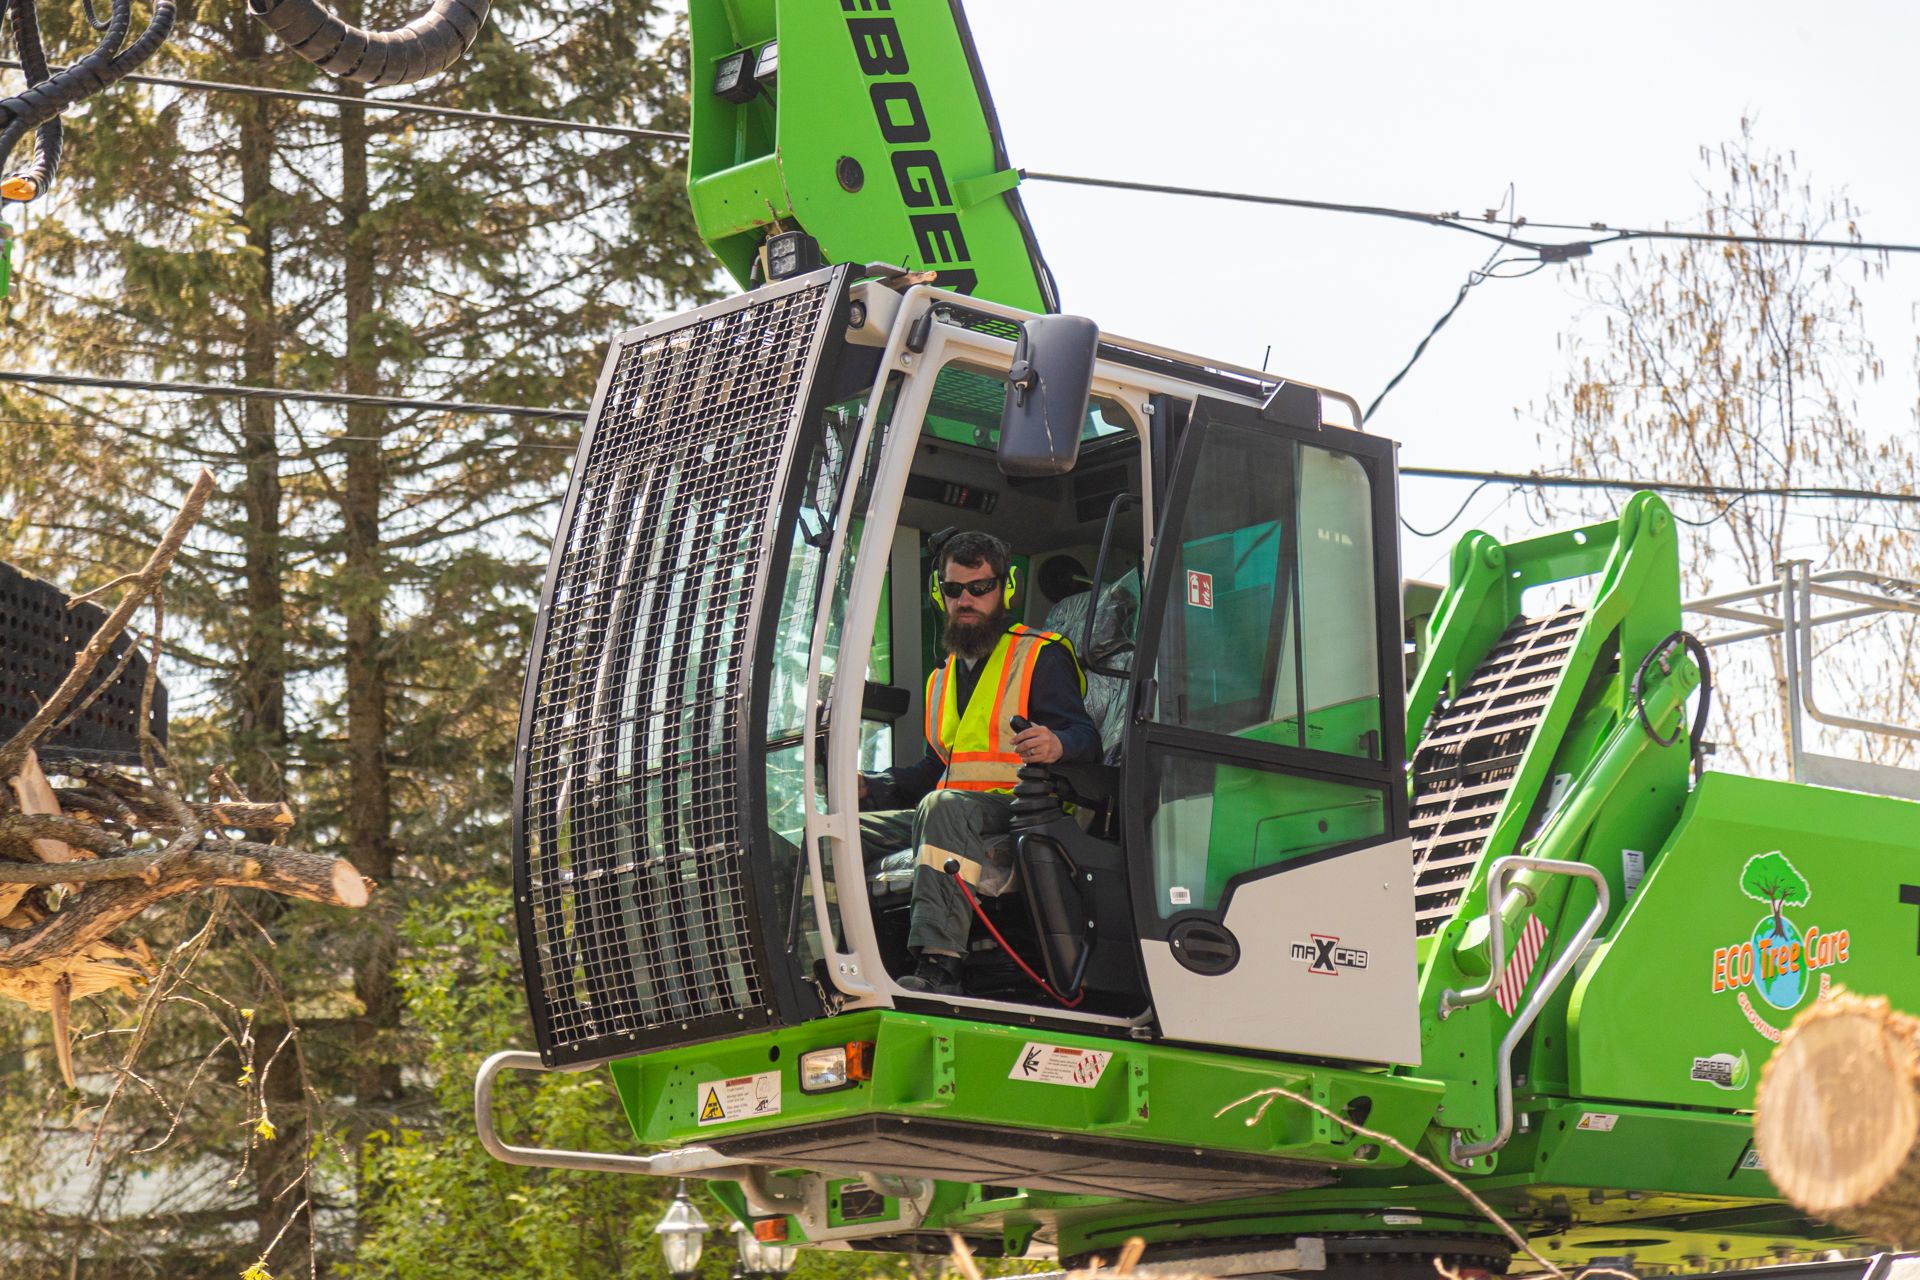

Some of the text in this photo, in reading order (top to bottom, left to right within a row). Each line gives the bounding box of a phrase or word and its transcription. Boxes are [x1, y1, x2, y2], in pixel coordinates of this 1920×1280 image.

[1713, 926, 1849, 992] ECO Tree Care
[1738, 992, 1781, 1043] GROWING
[1695, 1060, 1731, 1073] GREEN
